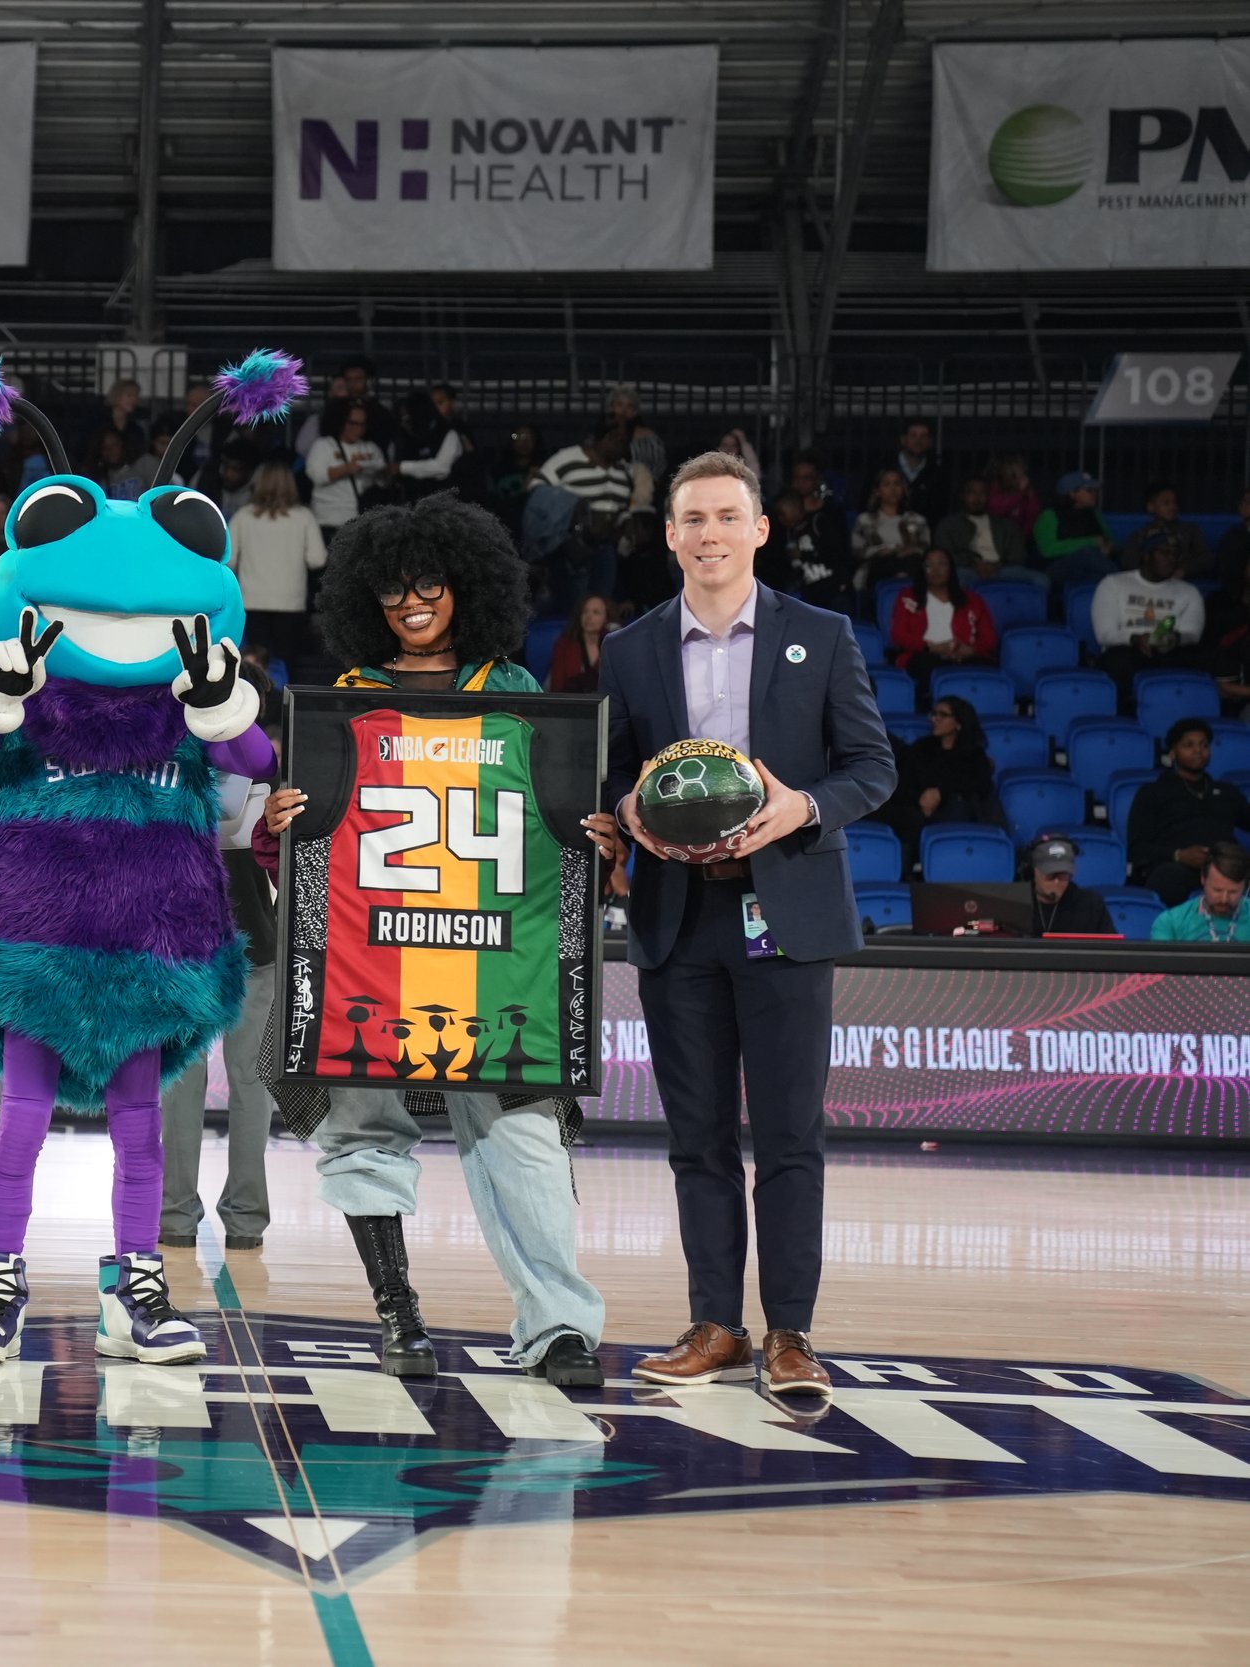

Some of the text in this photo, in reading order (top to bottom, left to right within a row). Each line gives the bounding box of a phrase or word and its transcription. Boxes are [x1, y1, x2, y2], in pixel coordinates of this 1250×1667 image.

[452, 118, 674, 155] NOVANT
[451, 164, 649, 202] HEALTH
[1097, 192, 1248, 210] PEST MANAGEMENT
[1124, 366, 1215, 405] 108
[392, 735, 505, 765] NBA G LEAGUE
[356, 785, 526, 896] 24
[377, 911, 502, 946] ROBINSON
[904, 1026, 920, 1069] G
[926, 1027, 1022, 1072] LEAGUE.
[1025, 1029, 1198, 1076] TOMORROW'S
